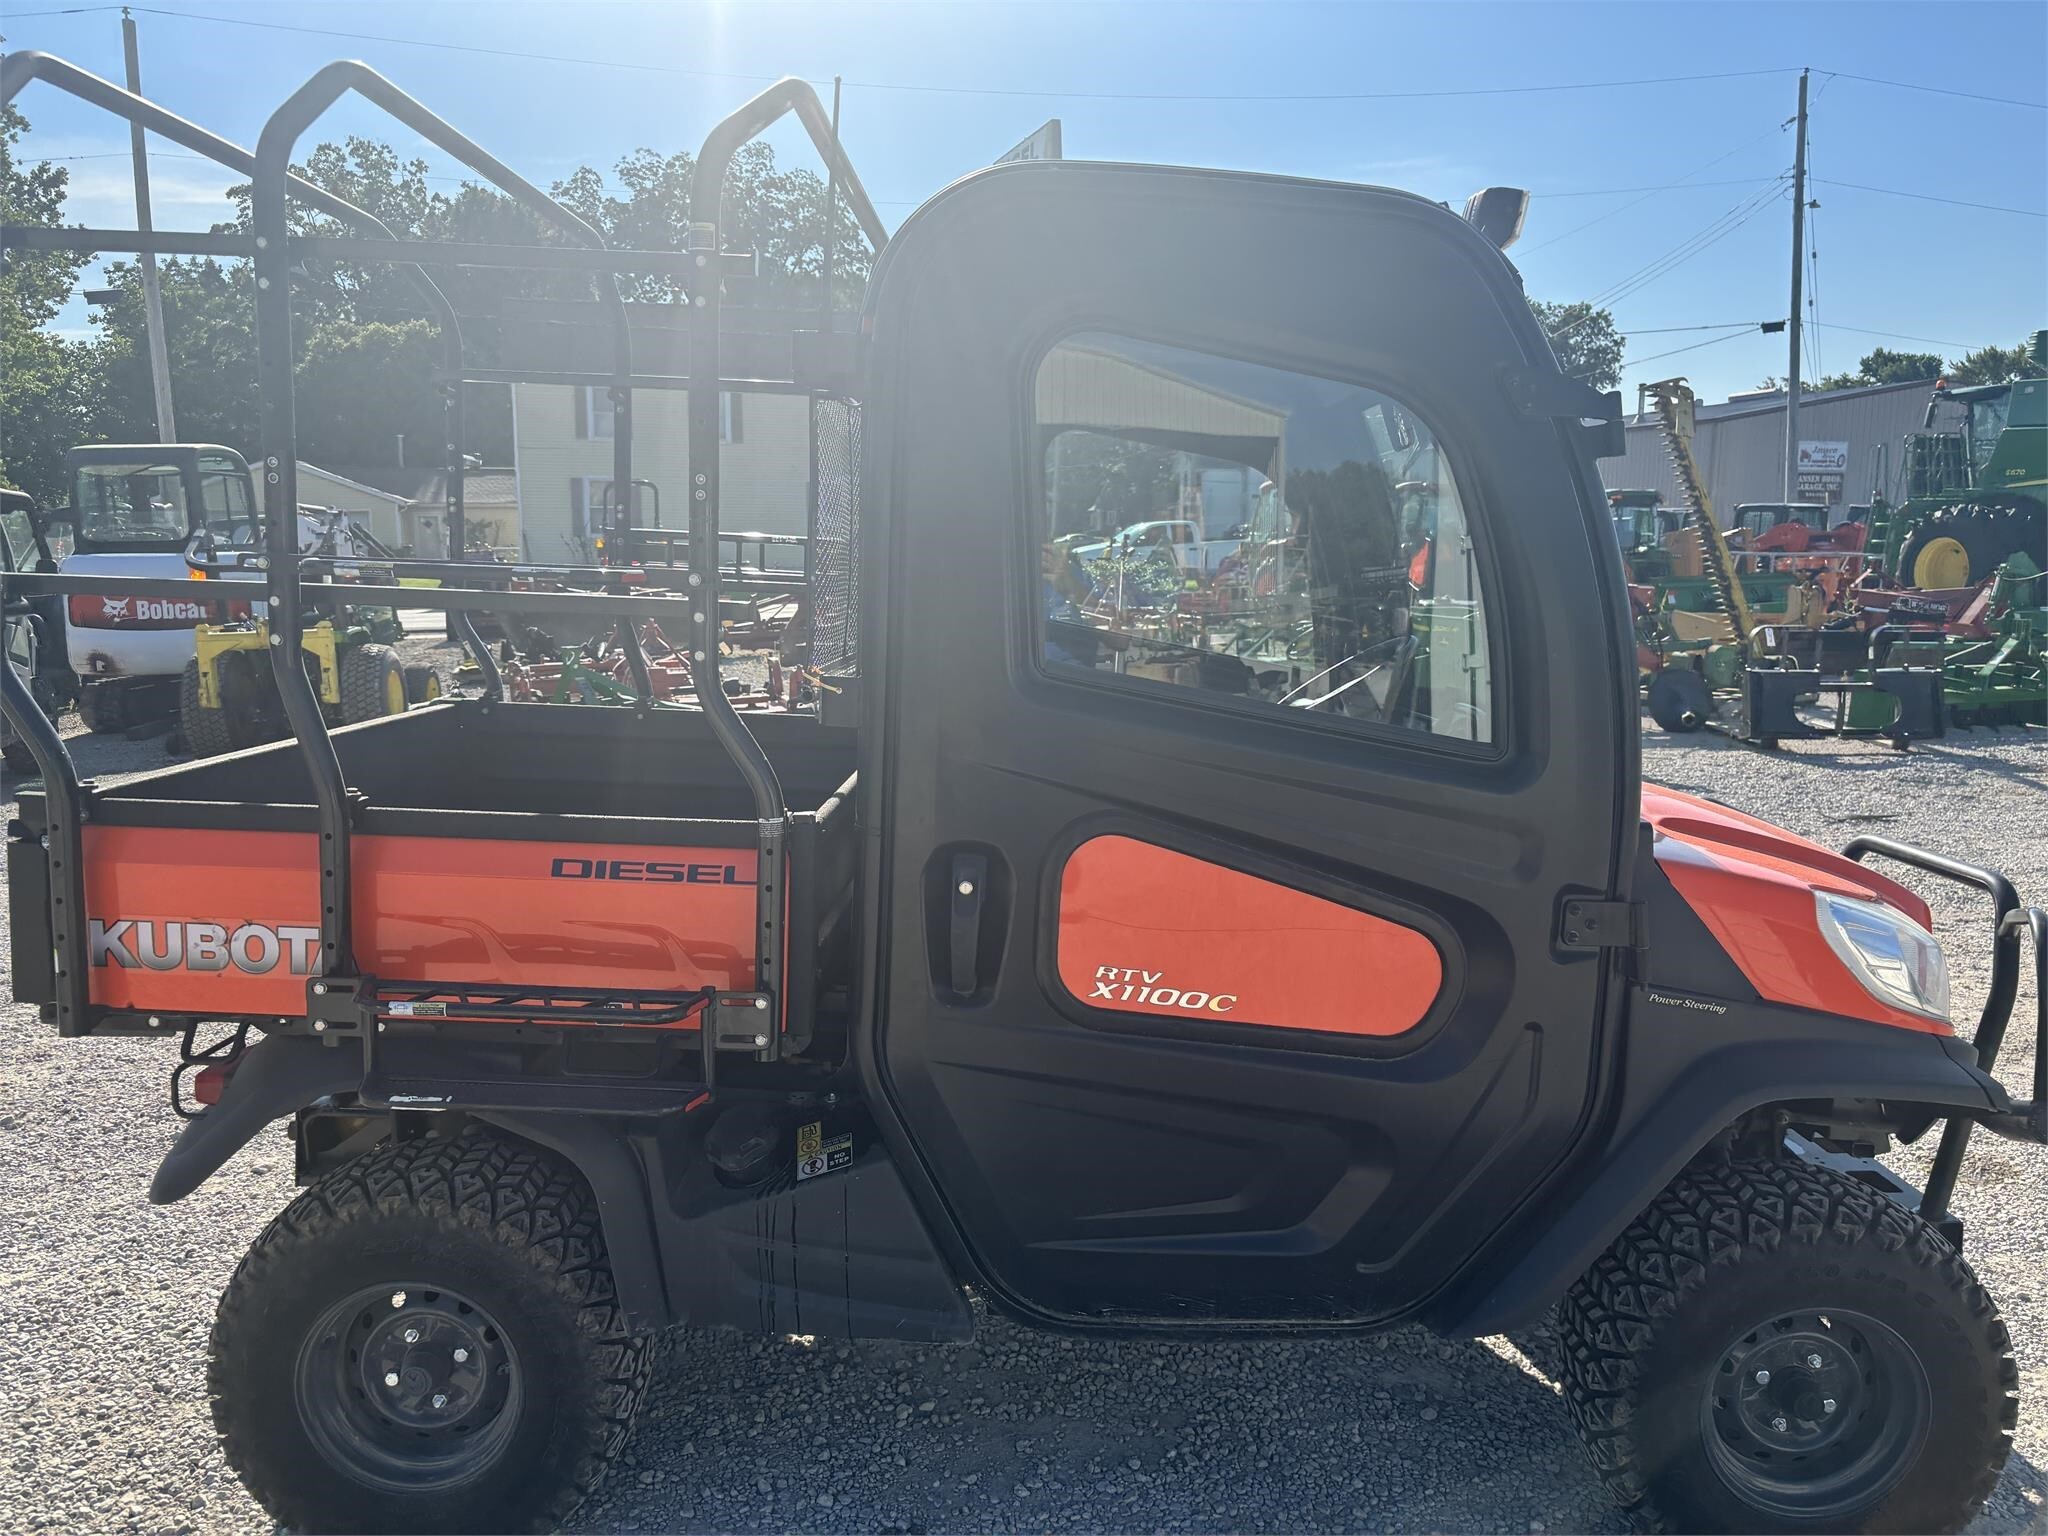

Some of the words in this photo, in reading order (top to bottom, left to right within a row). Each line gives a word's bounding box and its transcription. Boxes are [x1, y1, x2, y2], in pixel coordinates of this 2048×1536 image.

[1798, 475, 1821, 483] ANSEN
[551, 858, 758, 885] DIESEL
[89, 918, 323, 976] KUBOT
[1095, 966, 1163, 984] RTV
[1088, 981, 1237, 1012] X1100C
[1649, 993, 1682, 1006] Power
[1683, 999, 1727, 1015] Steering
[830, 1156, 849, 1165] STEP
